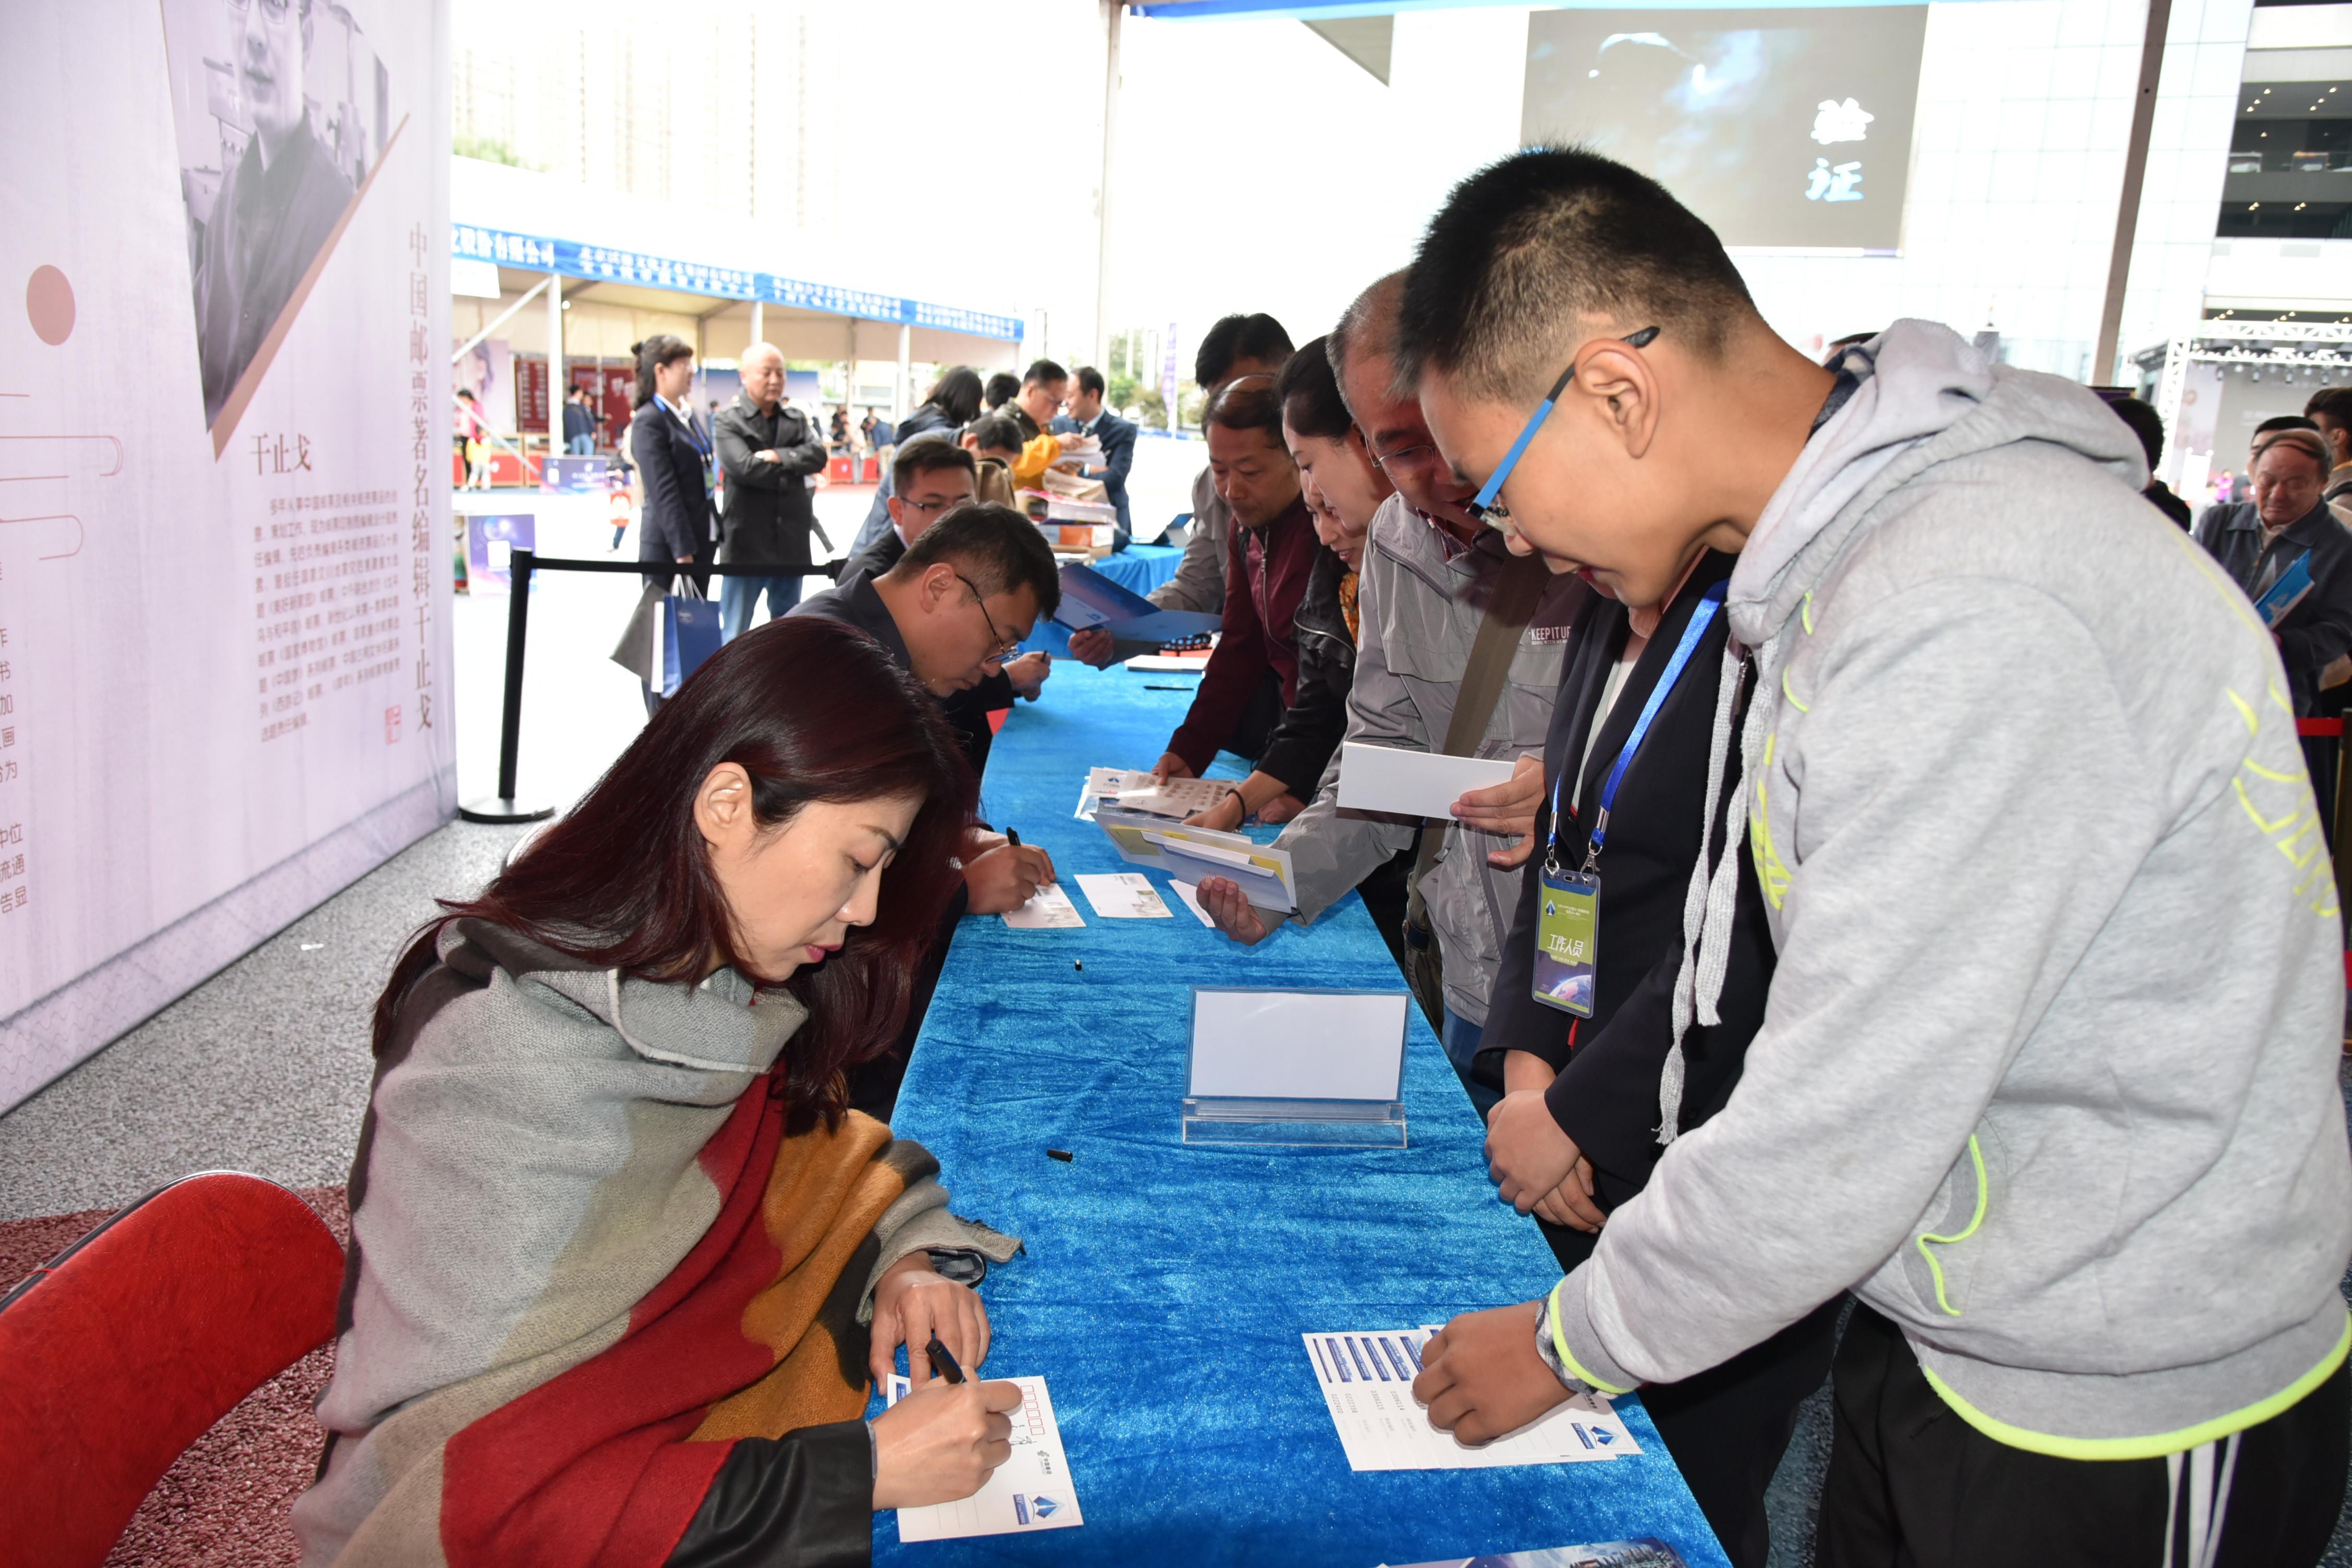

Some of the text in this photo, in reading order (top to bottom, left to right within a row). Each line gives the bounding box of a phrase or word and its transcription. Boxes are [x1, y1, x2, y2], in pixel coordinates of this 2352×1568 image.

[250, 432, 311, 475] 干止戈
[1531, 628, 1550, 640] KEEP
[1551, 627, 1560, 639] IT
[0, 694, 13, 715] 加
[0, 886, 28, 913] 告显
[1547, 934, 1584, 957] 工作人员
[1390, 1391, 1405, 1411] 0306114
